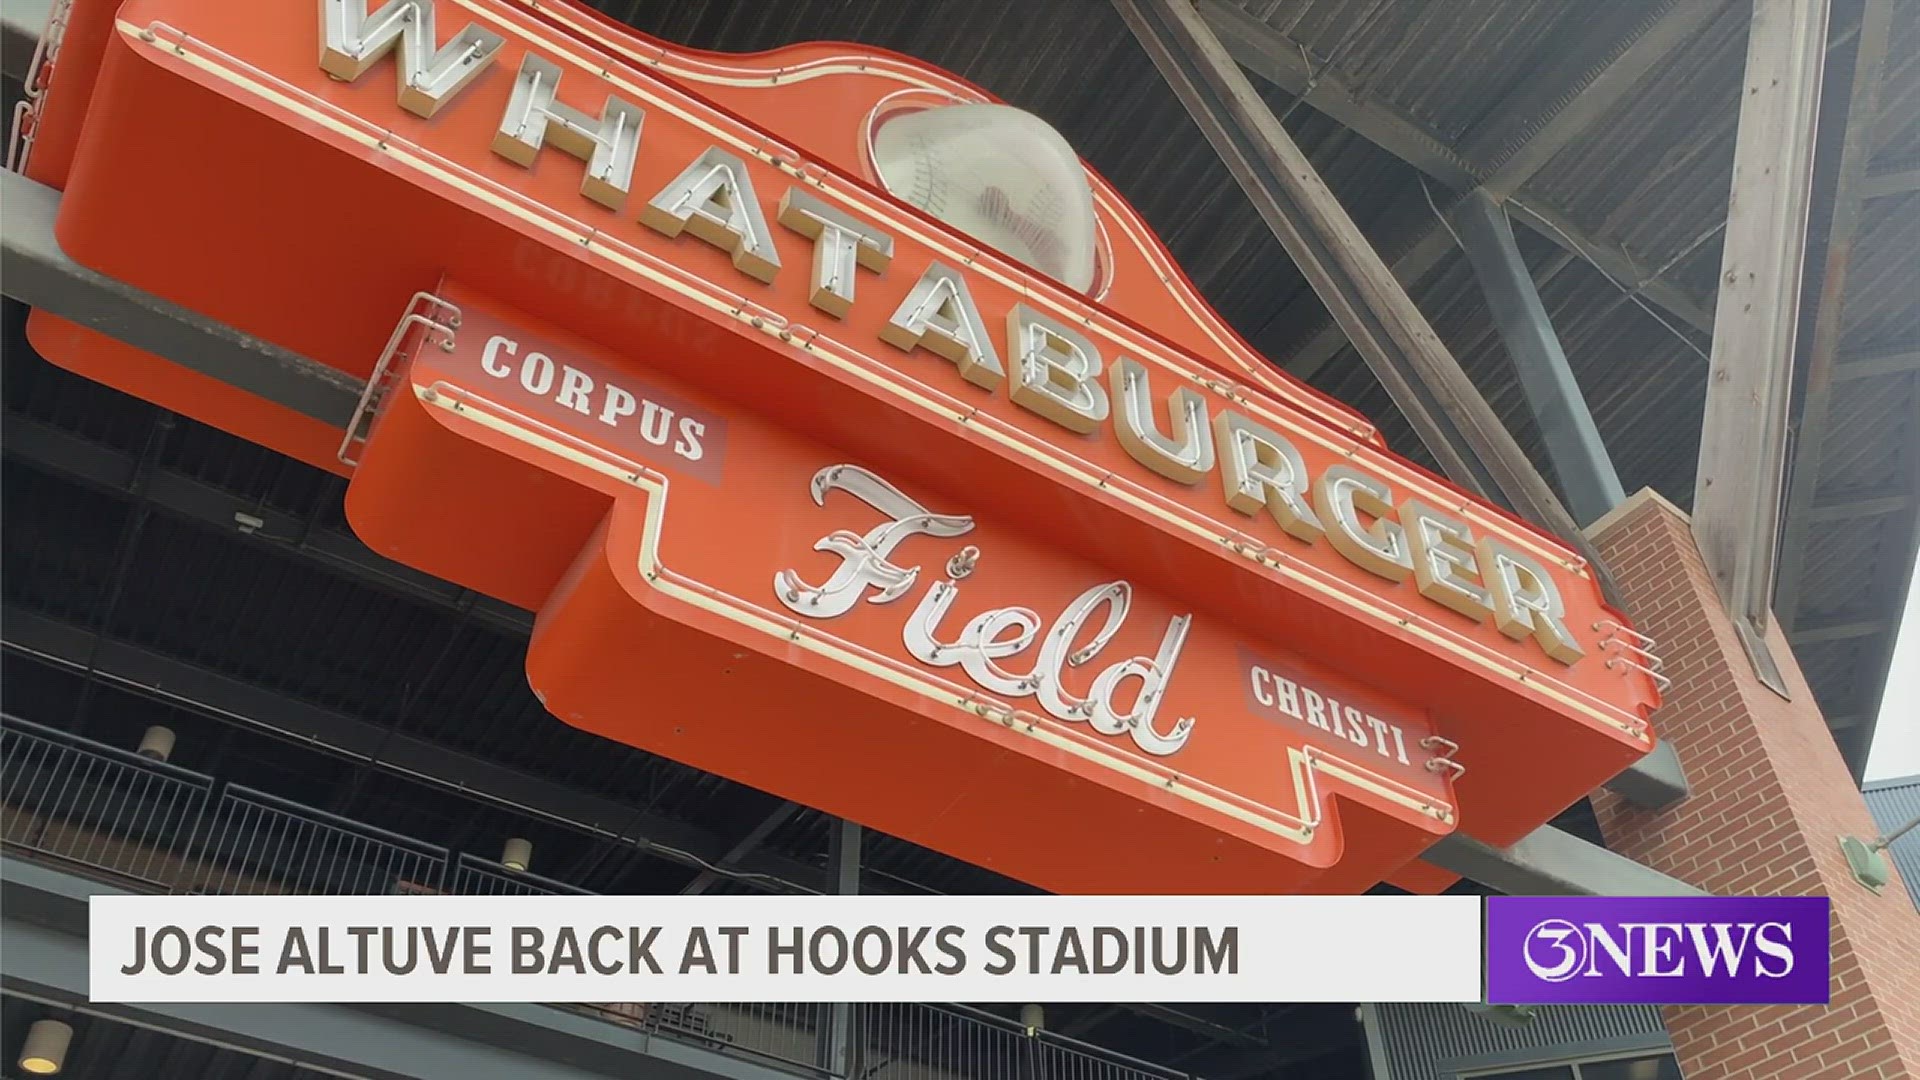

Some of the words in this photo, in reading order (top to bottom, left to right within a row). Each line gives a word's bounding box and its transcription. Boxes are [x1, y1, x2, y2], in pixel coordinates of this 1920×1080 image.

[318, 0, 1585, 665] WHATABURGER
[480, 335, 706, 463] CORPUS
[773, 463, 1195, 755] Field
[1250, 664, 1411, 766] CHRISTI
